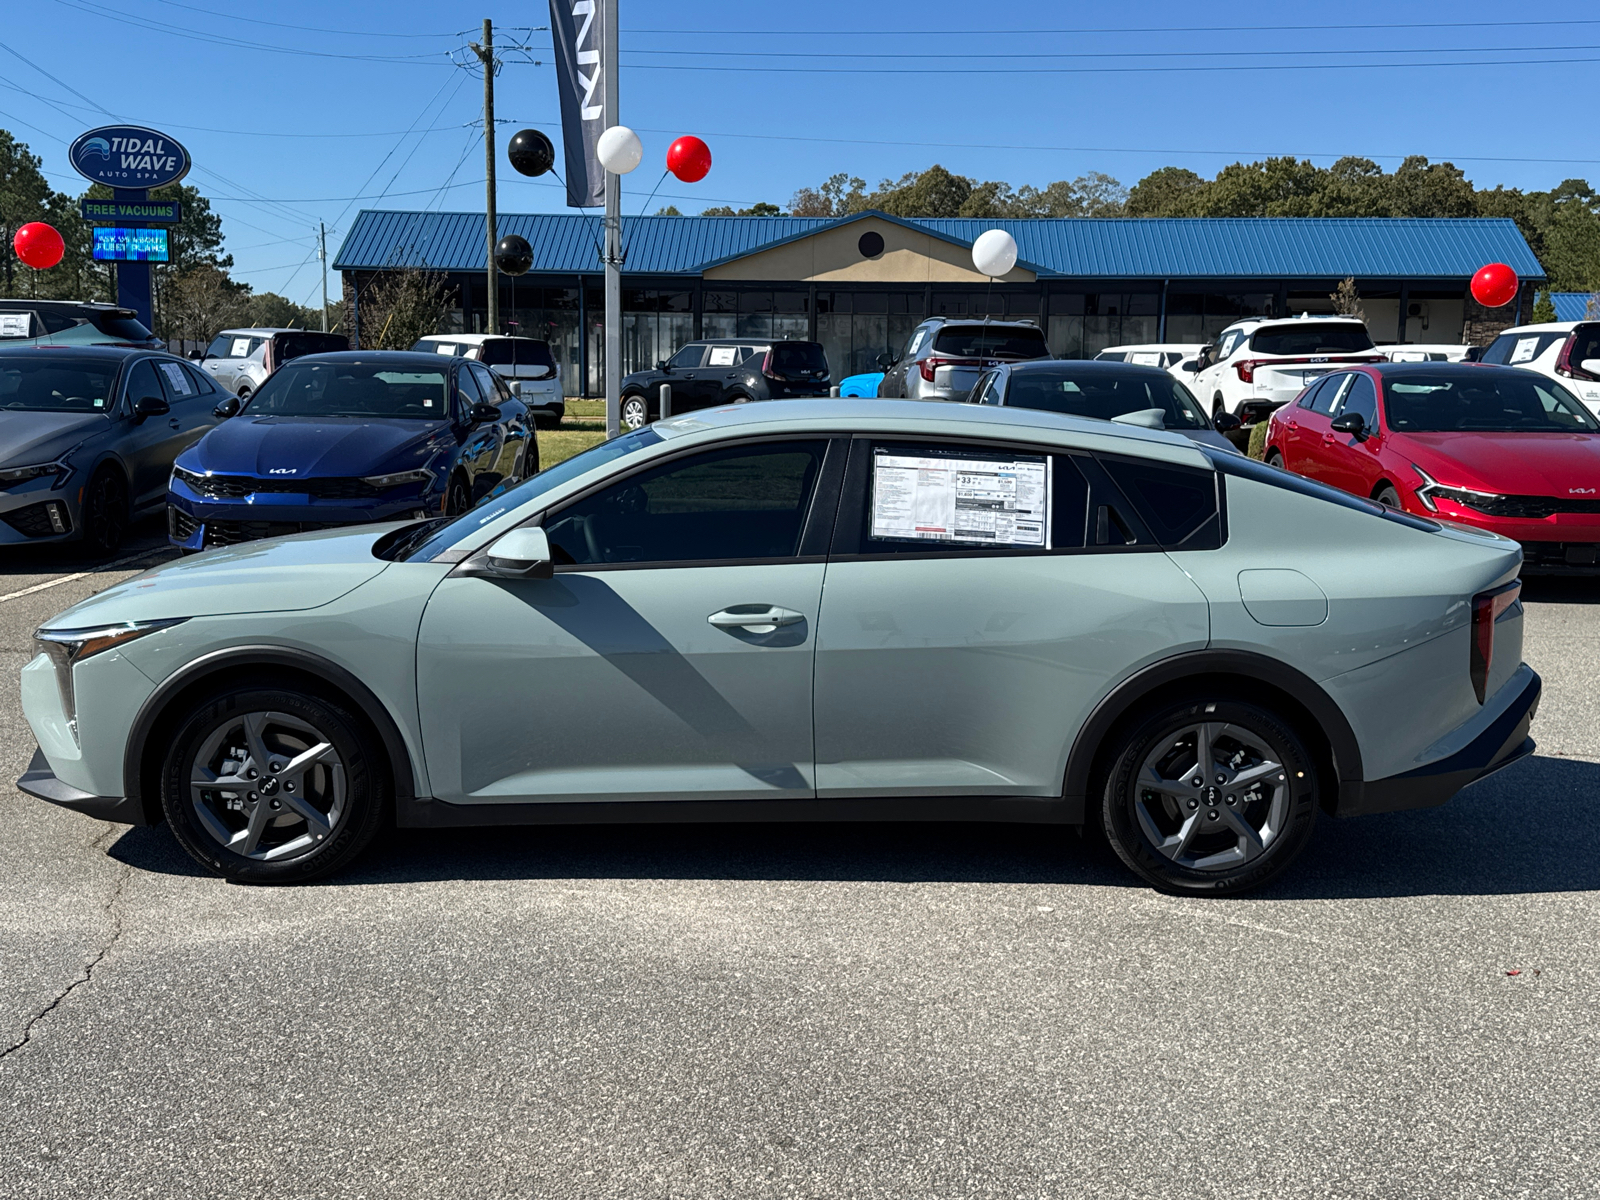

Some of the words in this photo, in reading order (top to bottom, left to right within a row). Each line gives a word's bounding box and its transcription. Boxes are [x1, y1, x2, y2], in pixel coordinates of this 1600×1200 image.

[111, 137, 165, 155] TIDAL
[120, 154, 177, 171] WAVE
[99, 170, 128, 178] AUTO
[136, 172, 158, 180] SPA
[86, 204, 116, 215] FREE
[118, 205, 174, 217] VACUUMS
[96, 243, 126, 252] FLEET
[961, 476, 972, 485] 33
[1117, 748, 1138, 808] SOLUS
[170, 765, 188, 826] SOLUS
[301, 828, 353, 872] KUMHO
[1214, 860, 1275, 889] KUMHO
